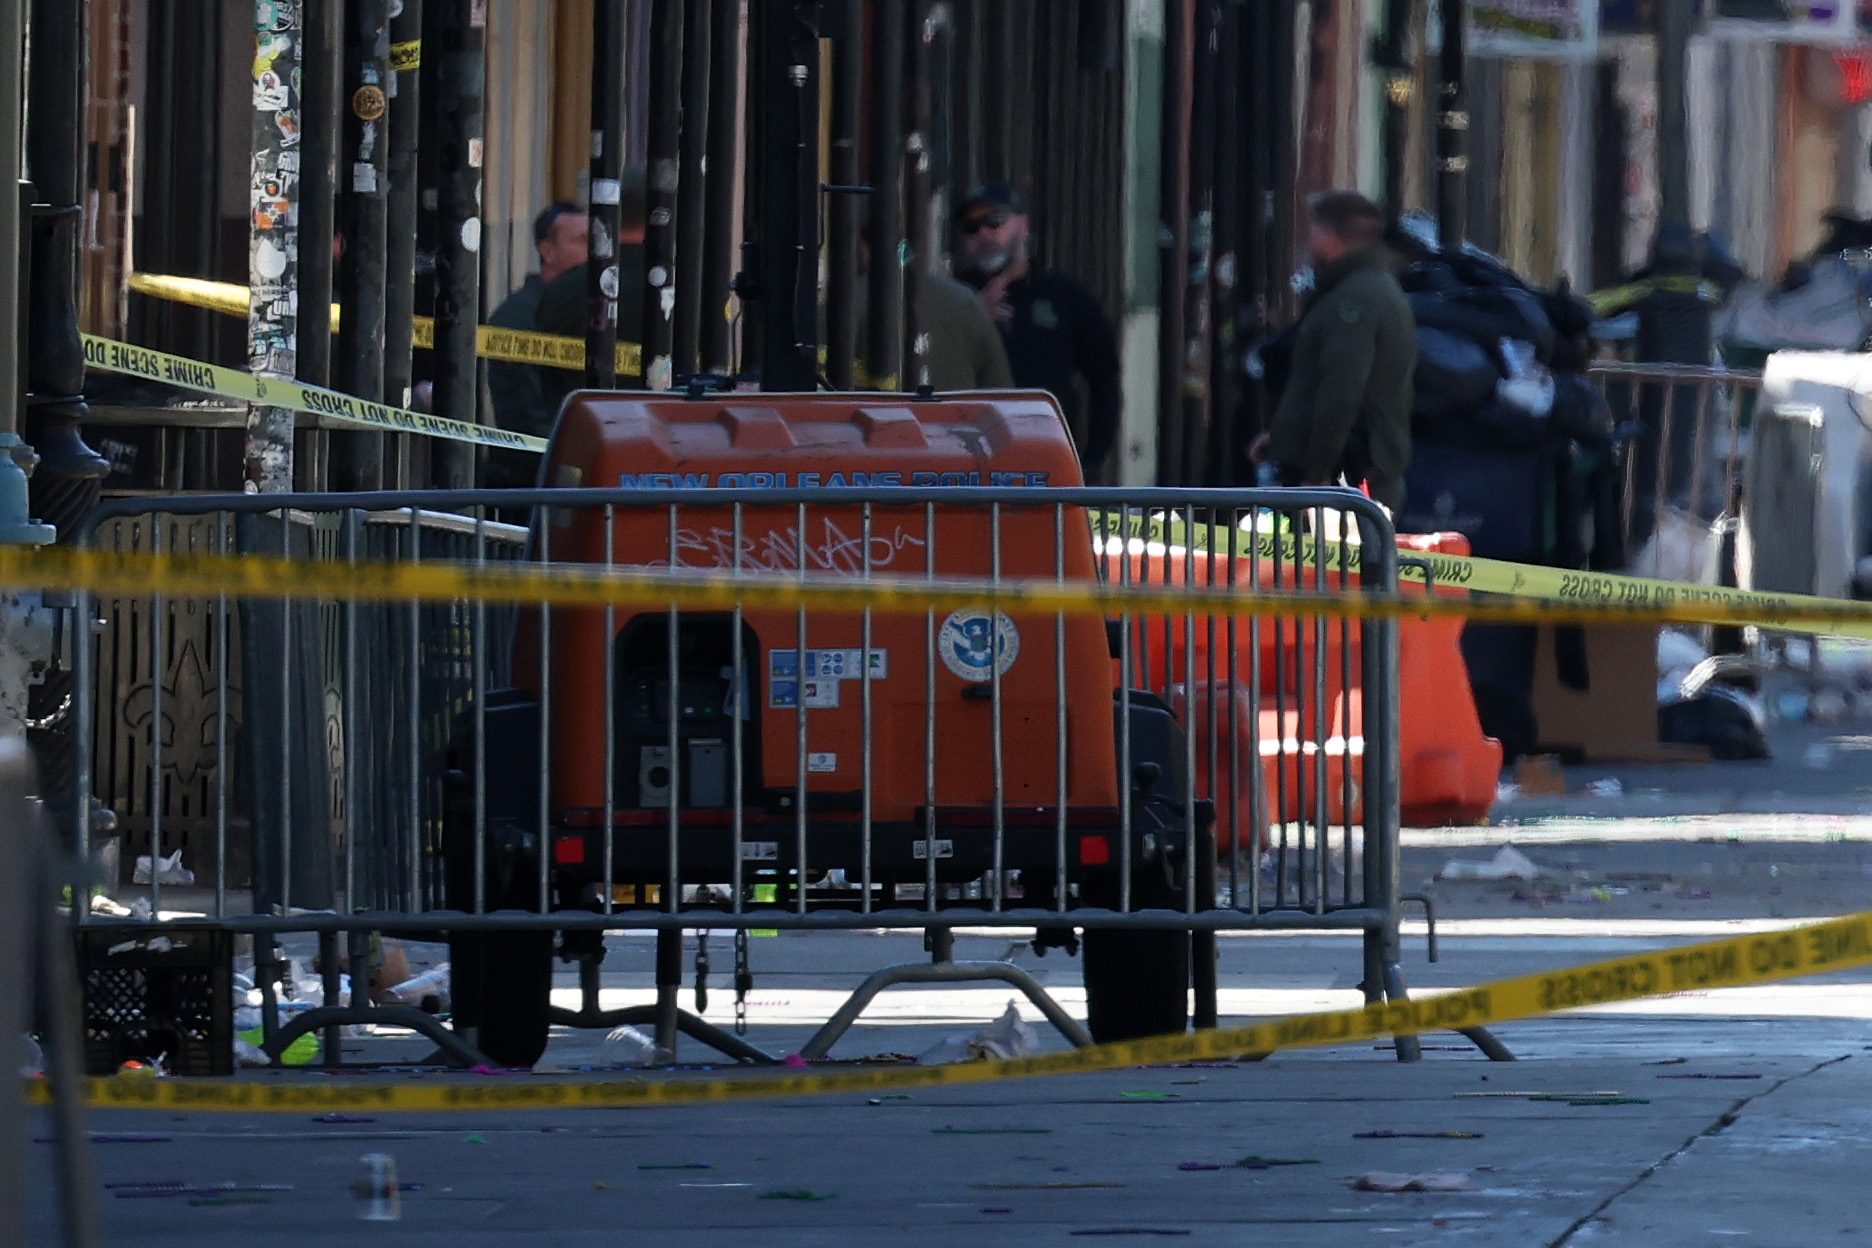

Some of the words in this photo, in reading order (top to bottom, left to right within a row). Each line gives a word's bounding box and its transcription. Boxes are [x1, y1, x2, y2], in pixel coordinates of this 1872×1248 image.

[84, 339, 106, 365] DO
[111, 345, 160, 377] SCENE
[164, 357, 216, 390] CRIME
[301, 388, 356, 420] CROSS
[360, 402, 389, 426] NOT
[394, 410, 416, 430] DO
[419, 416, 469, 439] SCENE
